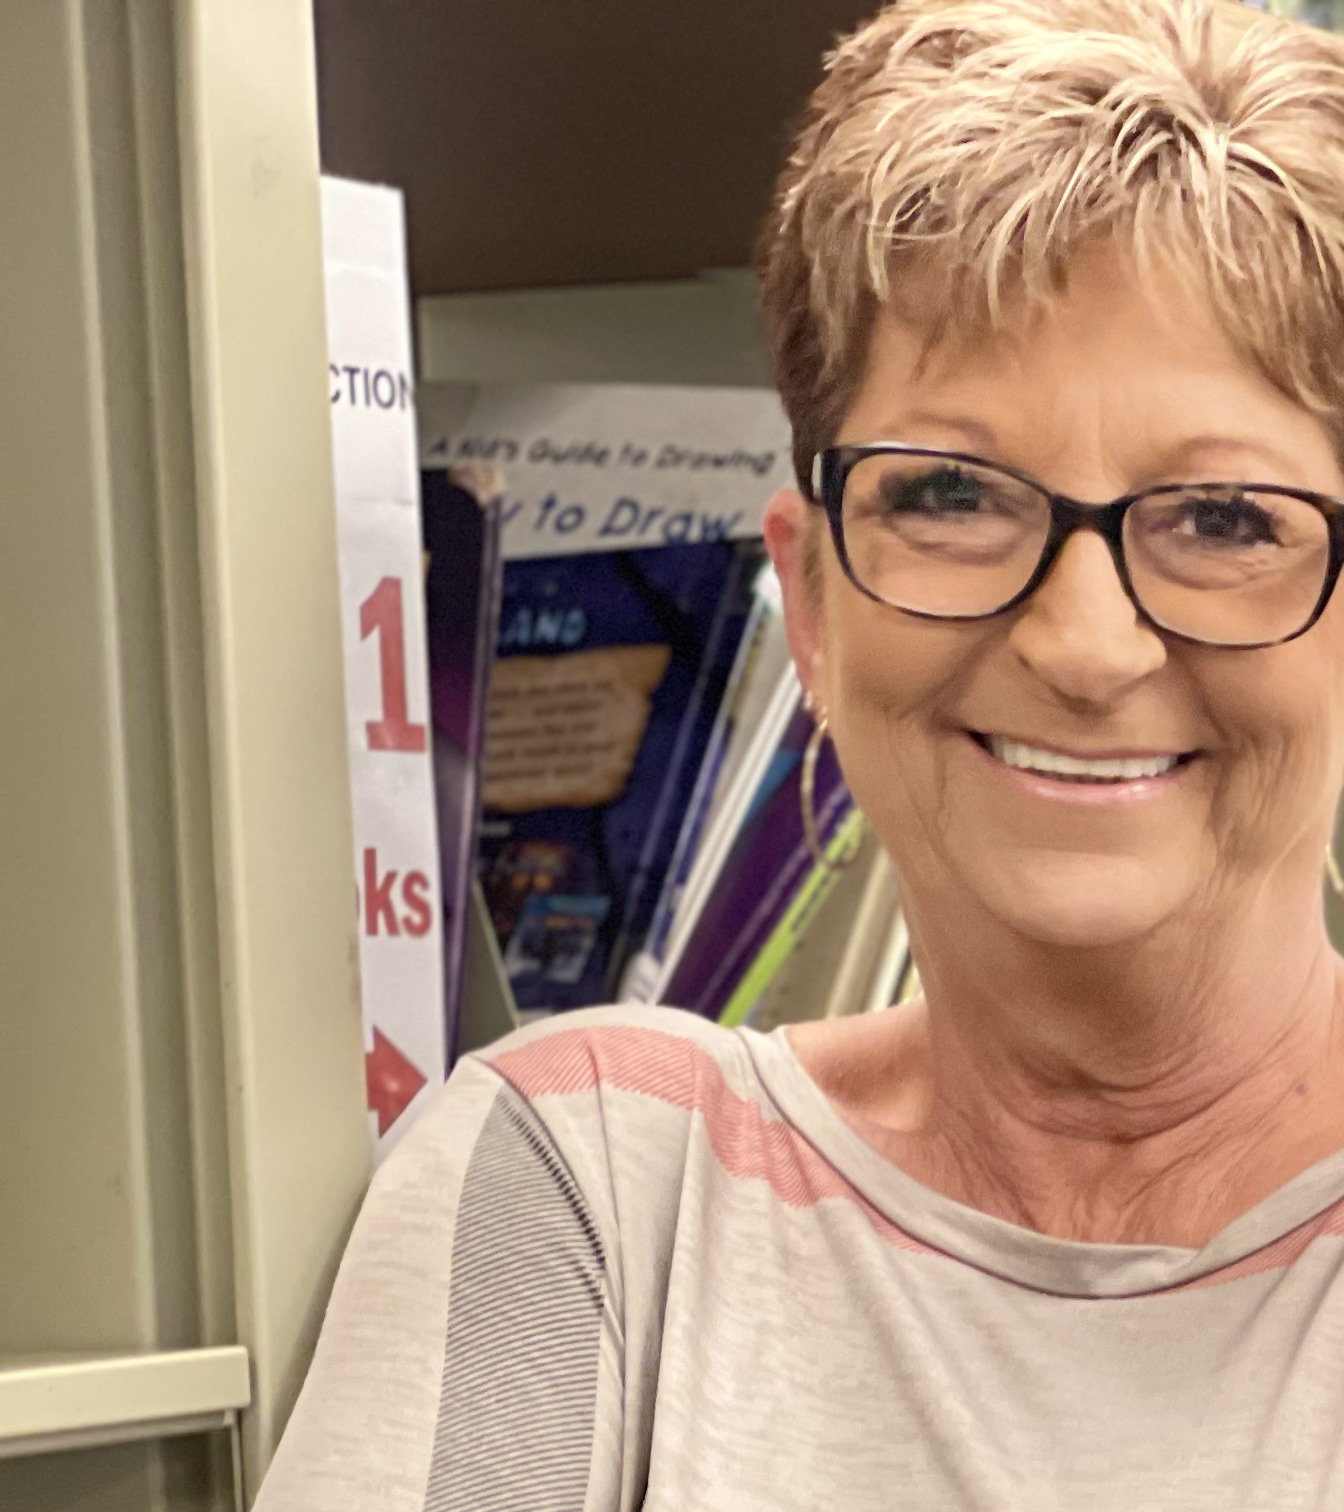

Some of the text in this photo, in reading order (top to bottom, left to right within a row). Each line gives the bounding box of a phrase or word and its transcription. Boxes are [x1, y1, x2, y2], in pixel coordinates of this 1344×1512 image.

[427, 439, 448, 457] A
[525, 439, 610, 468] Guide
[617, 445, 648, 468] to
[654, 445, 775, 477] Drawing
[534, 492, 587, 534] to
[595, 496, 744, 546] Draw
[359, 576, 426, 752] 1
[355, 848, 431, 939] ks
